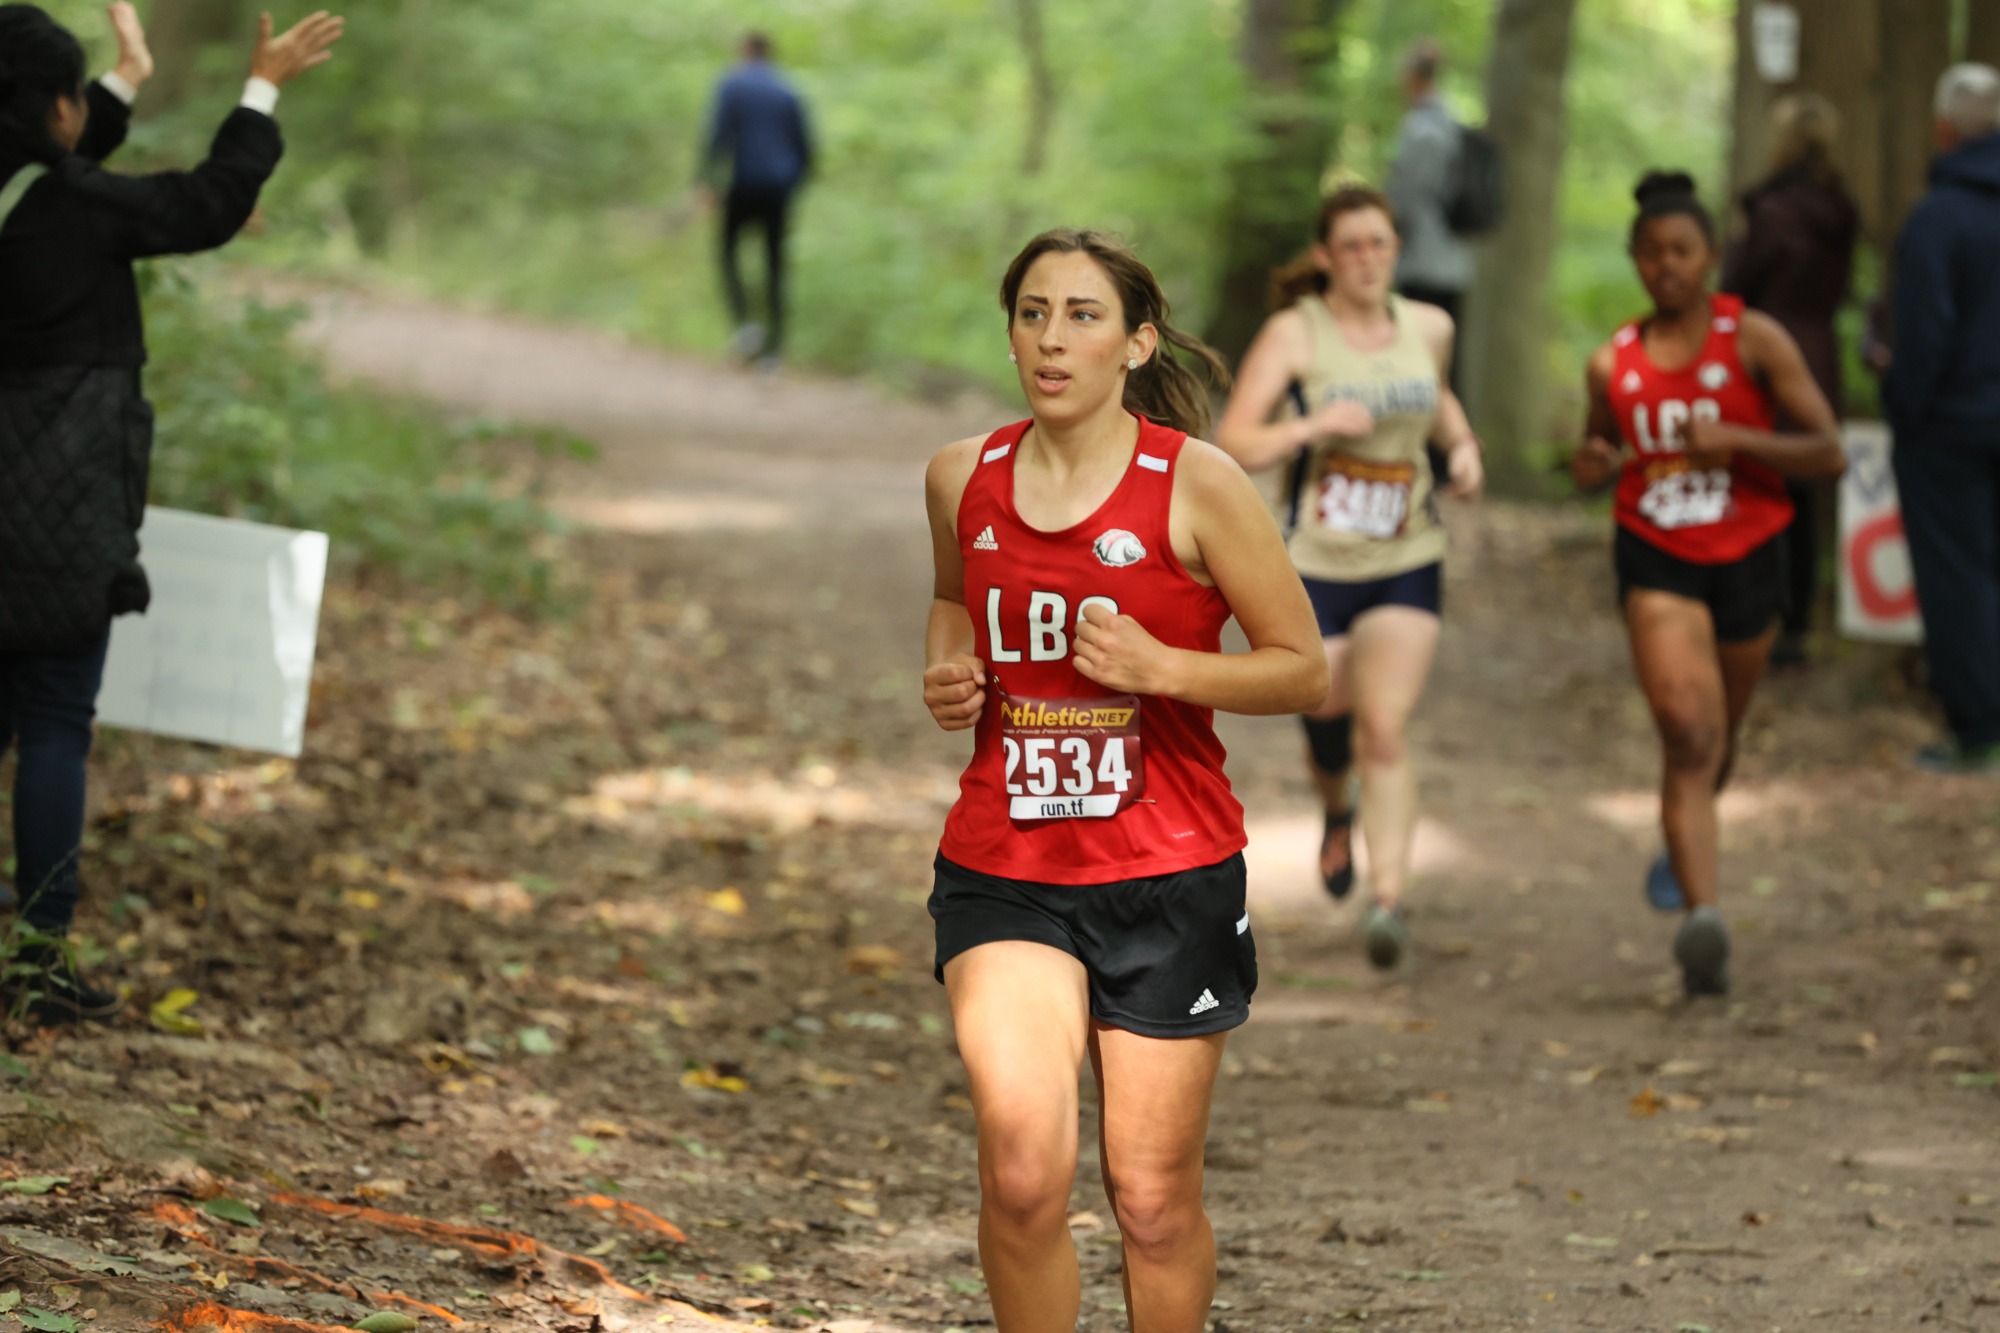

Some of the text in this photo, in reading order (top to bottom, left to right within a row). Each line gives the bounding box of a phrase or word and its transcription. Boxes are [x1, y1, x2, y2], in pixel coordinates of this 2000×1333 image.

[973, 541, 999, 550] adidas
[1095, 712, 1128, 723] NET
[1003, 736, 1133, 796] 2534
[1041, 798, 1084, 816] run.tf
